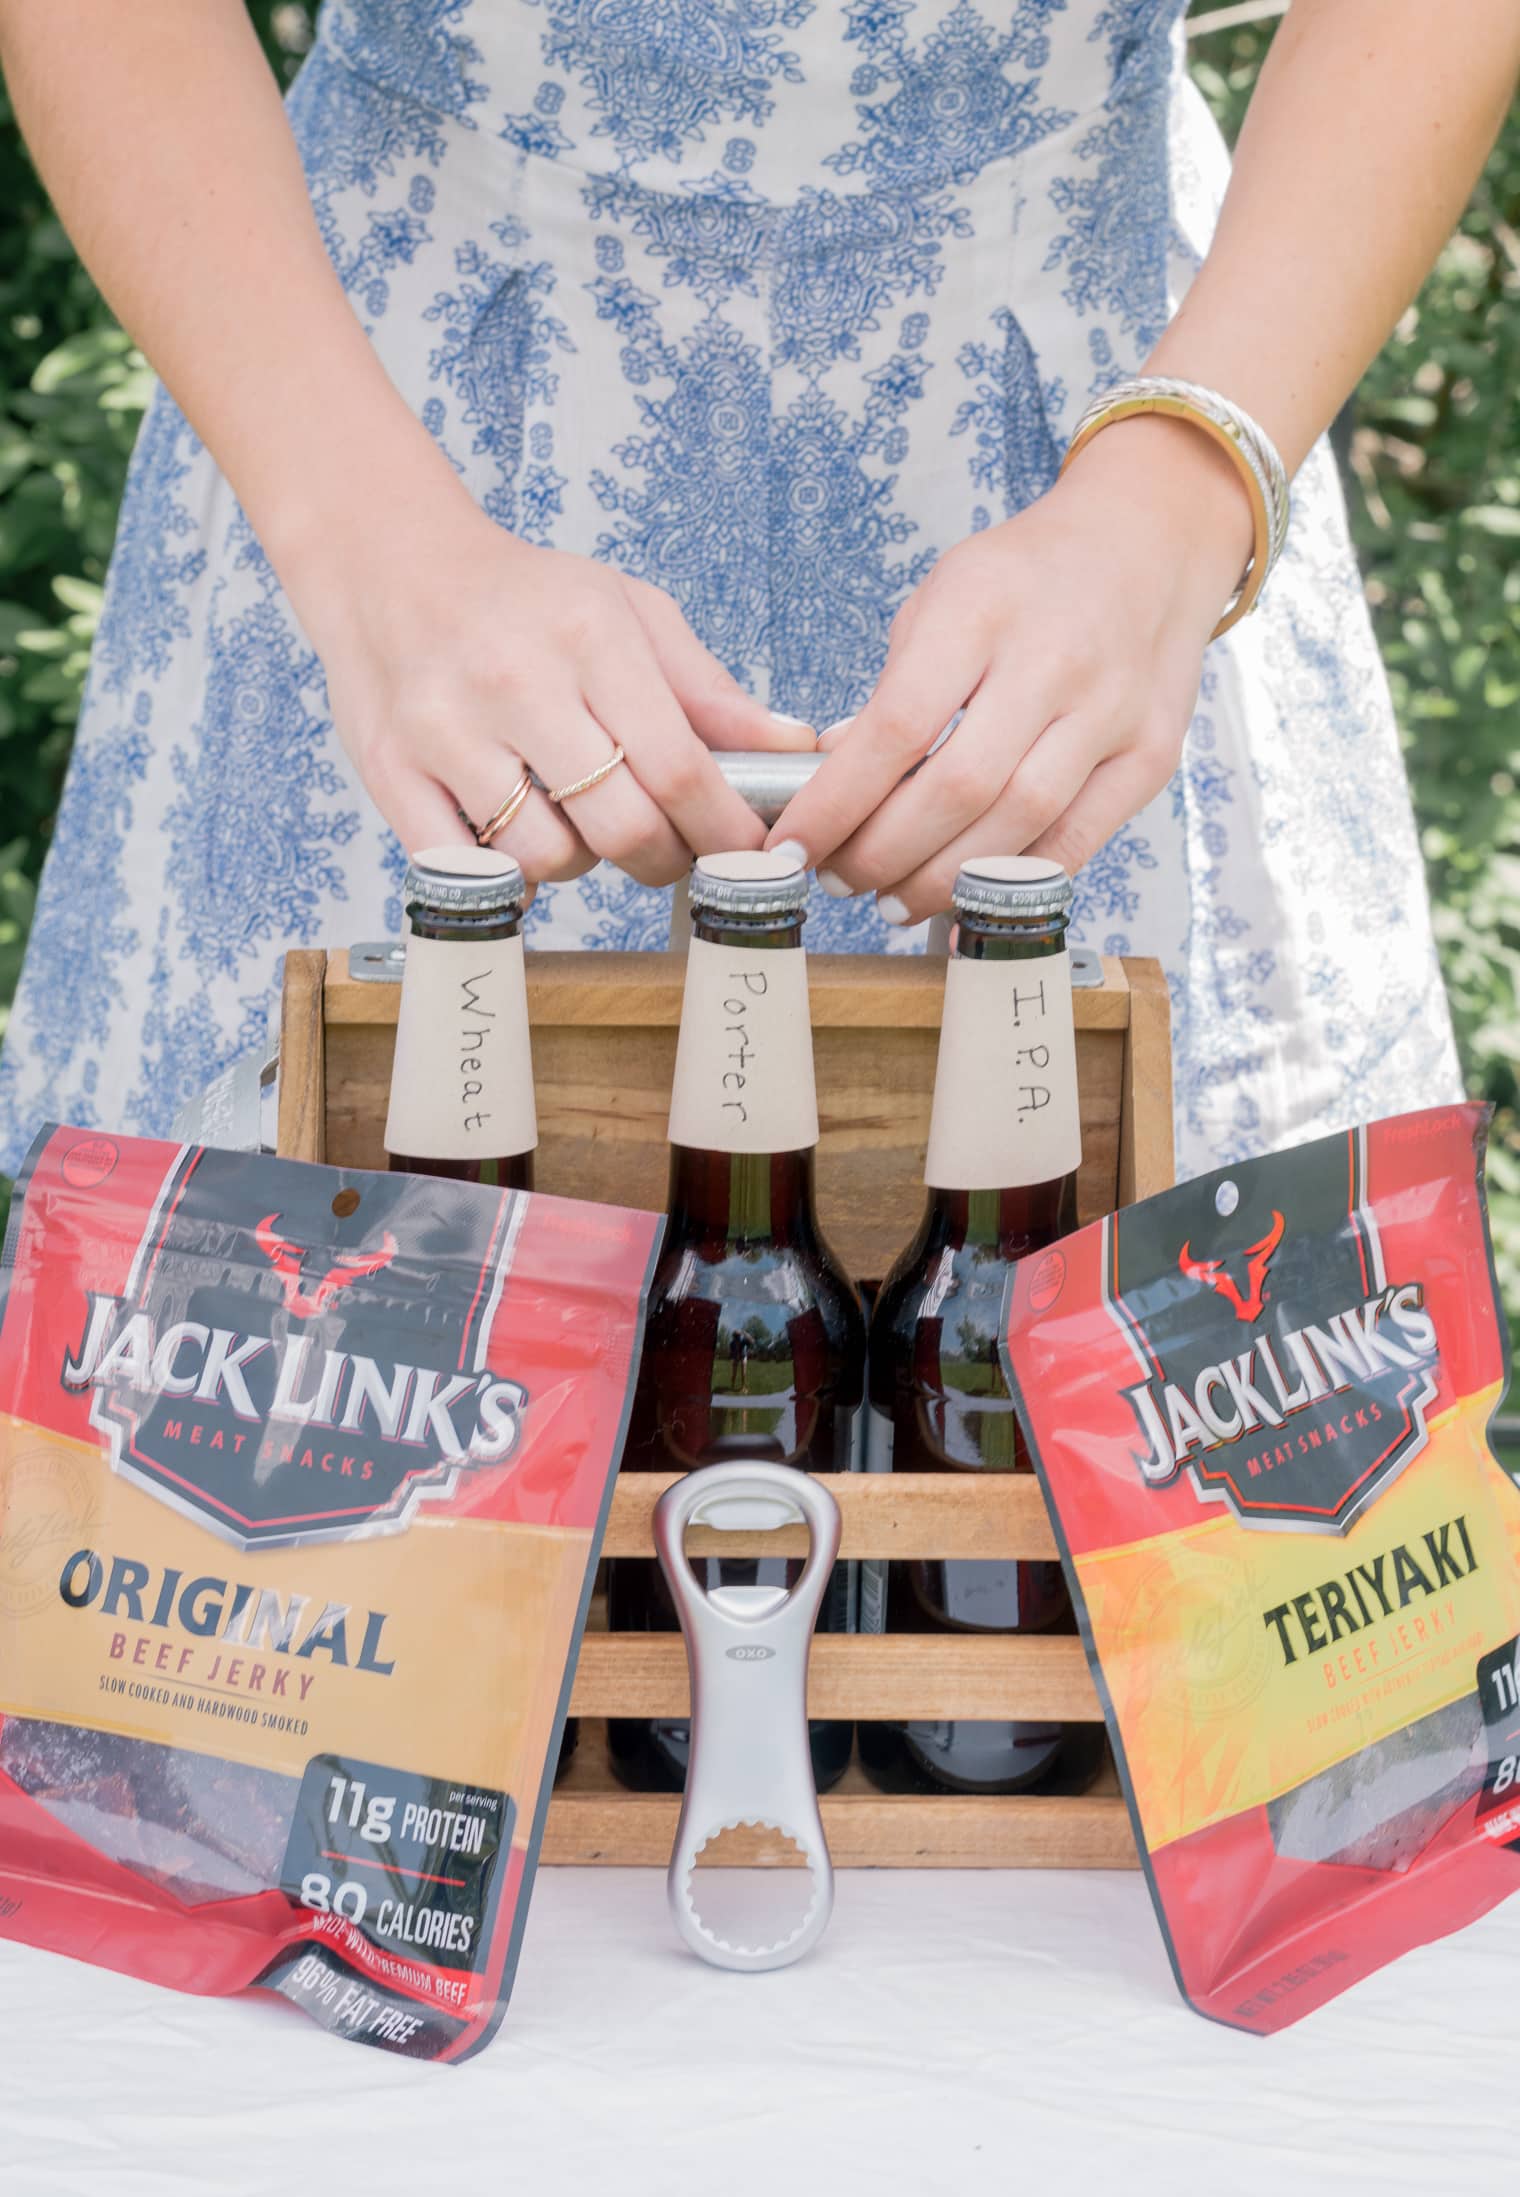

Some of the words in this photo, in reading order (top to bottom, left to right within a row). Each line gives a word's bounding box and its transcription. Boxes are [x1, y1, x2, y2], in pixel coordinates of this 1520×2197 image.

[460, 969, 496, 1132] Wheat
[722, 970, 768, 1123] Porter
[65, 1294, 262, 1422] JACK
[268, 1333, 528, 1459] LINK'S
[1130, 1351, 1288, 1482] JACK
[1255, 1284, 1438, 1416] LINK'S
[163, 1419, 248, 1455] MEAT
[260, 1440, 375, 1481] SNACKS
[1247, 1441, 1294, 1478] MEAT
[1297, 1402, 1384, 1455] SNACKS
[60, 1548, 396, 1677] ORIGINAL
[1263, 1514, 1480, 1667] TERIYAKI
[110, 1632, 195, 1674] BEEF
[207, 1655, 316, 1702] JERKY
[735, 1647, 767, 1658] OXO
[1323, 1639, 1379, 1689] BEEF
[1389, 1600, 1456, 1657] JERKY
[99, 1674, 126, 1695] SLOW
[128, 1681, 170, 1706] COOKED
[171, 1691, 195, 1711] AND
[197, 1697, 259, 1725] HARDWOOD
[260, 1711, 310, 1737] SMOKED
[1491, 1662, 1520, 1712] 11
[449, 1791, 465, 1804] per
[465, 1795, 498, 1813] serving
[1493, 1754, 1520, 1796] 8
[328, 1776, 397, 1844] 11g
[400, 1802, 487, 1855] PROTEIN
[301, 1872, 368, 1926] 80
[376, 1899, 475, 1953] CALORIES
[292, 1953, 341, 2006] 96%
[333, 1983, 380, 2028] FAT
[368, 2002, 425, 2045] FREE
[435, 1977, 468, 2006] BEEF
